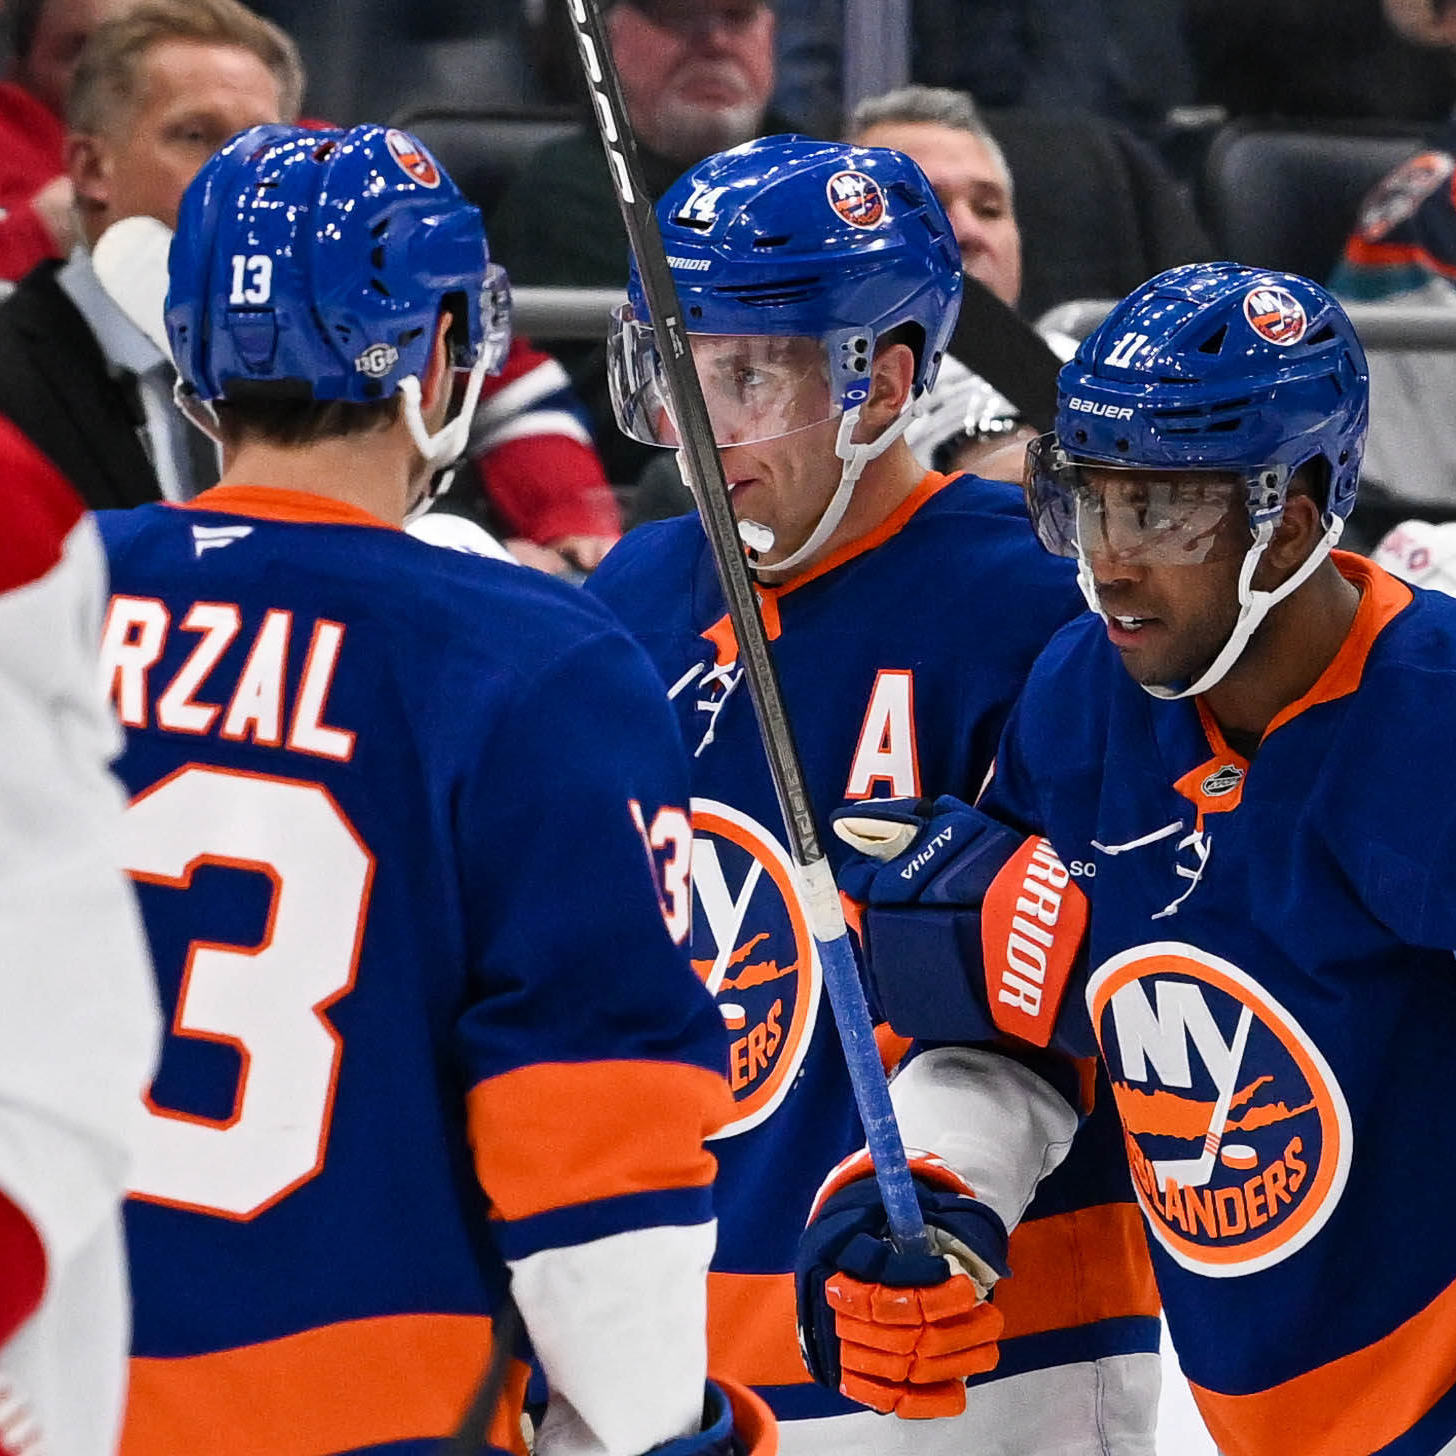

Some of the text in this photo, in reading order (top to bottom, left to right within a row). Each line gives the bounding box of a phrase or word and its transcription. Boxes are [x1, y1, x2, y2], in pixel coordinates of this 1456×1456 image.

[677, 183, 732, 222] 14
[229, 254, 273, 305] 13
[666, 256, 711, 271] RRIOR
[1104, 331, 1149, 368] 11
[1068, 396, 1135, 422] BAUER
[101, 593, 357, 762] RZAL
[843, 668, 922, 800] A
[899, 824, 954, 882] ALPHA
[998, 837, 1070, 1017] RRIOR
[117, 761, 377, 1223] 3
